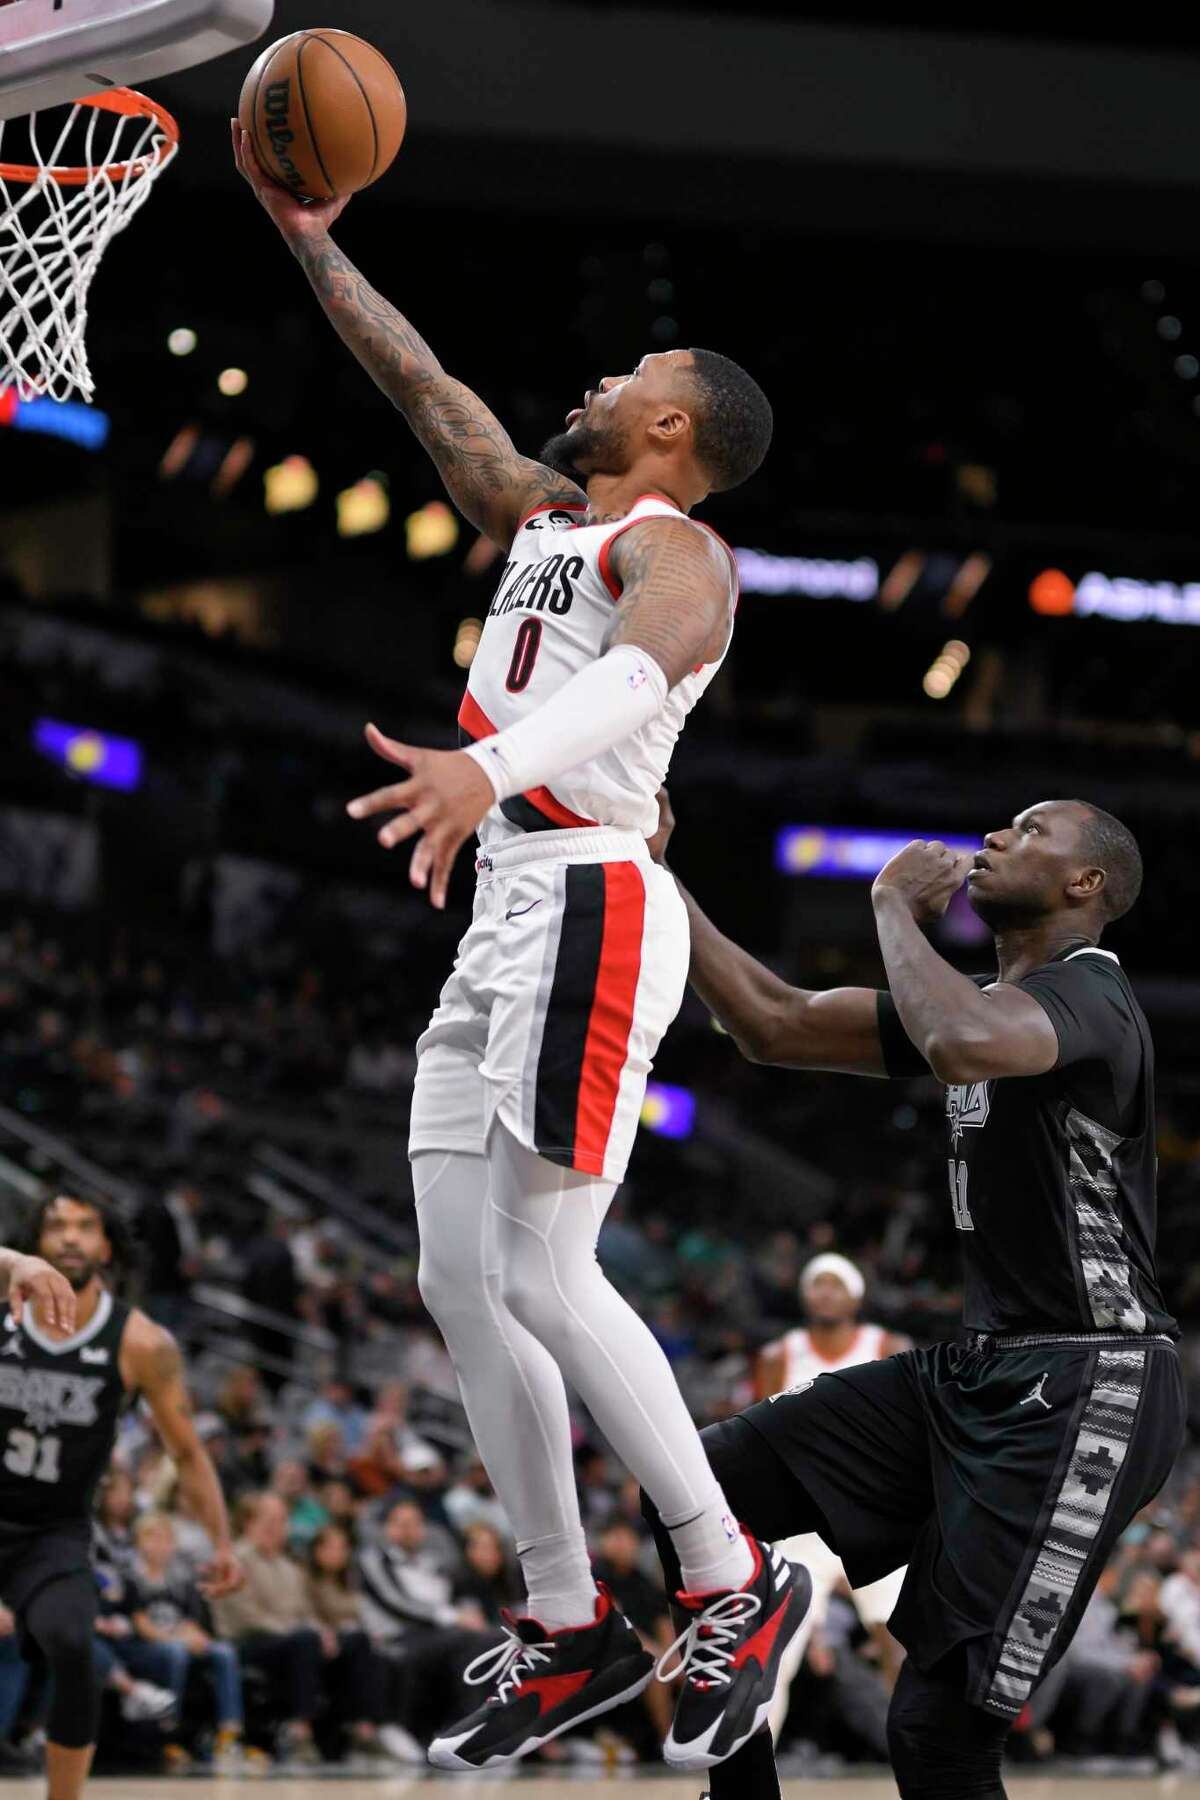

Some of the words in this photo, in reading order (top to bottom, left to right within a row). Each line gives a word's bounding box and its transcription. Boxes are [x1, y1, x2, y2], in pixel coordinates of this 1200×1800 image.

[264, 78, 306, 188] Wilson
[489, 553, 584, 616] LAZERS
[505, 616, 543, 694] 0
[4, 1427, 61, 1484] 31
